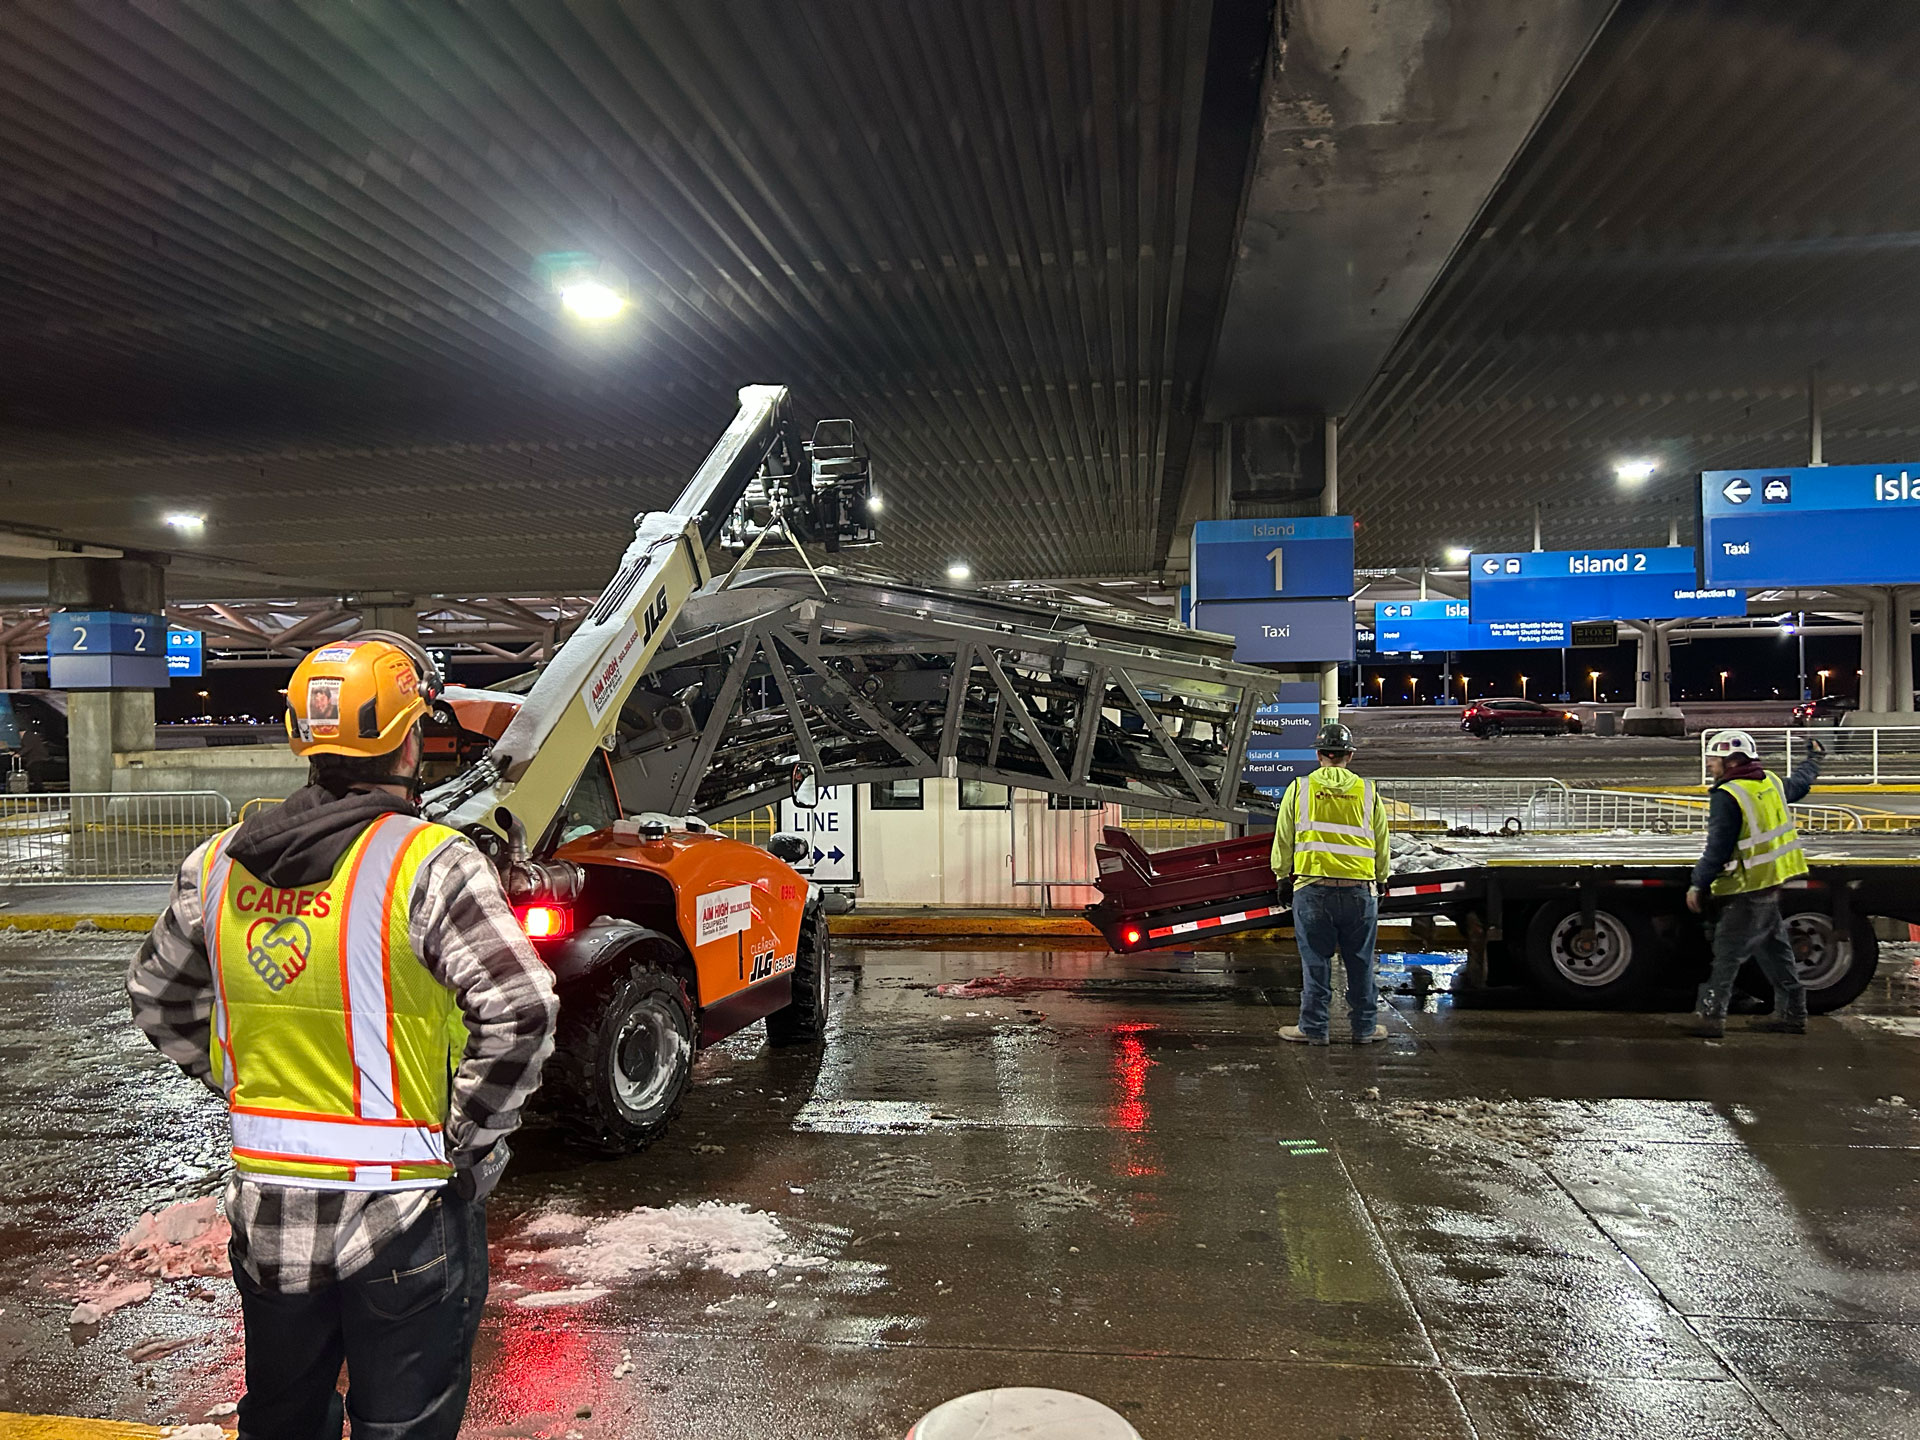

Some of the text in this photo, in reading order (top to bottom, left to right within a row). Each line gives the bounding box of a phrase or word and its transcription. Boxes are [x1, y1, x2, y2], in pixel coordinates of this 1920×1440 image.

[1253, 523, 1295, 537] Island
[1722, 541, 1750, 556] Taxi
[1266, 547, 1284, 592] 1
[1569, 553, 1647, 574] Island 2
[1674, 589, 1695, 599] Limo
[69, 614, 91, 622] Island
[643, 583, 669, 648] JLG
[1262, 624, 1290, 638] Taxi
[1541, 621, 1564, 630] Parking
[72, 626, 88, 651] 2
[134, 628, 146, 652] 2
[591, 679, 605, 703] AIM
[602, 657, 619, 684] HIGH
[594, 667, 621, 710] EQUIPMENT
[1273, 705, 1279, 713] 3
[1281, 717, 1312, 727] Shuttle,
[1249, 751, 1272, 759] Island
[1249, 764, 1294, 772] Rental Cars
[1274, 788, 1280, 796] 5
[794, 812, 839, 832] LINE
[236, 884, 332, 918] CARES
[702, 907, 714, 922] AIM
[715, 901, 729, 919] HIGH
[702, 916, 729, 931] EQUIPMENT
[750, 937, 778, 955] CLEARSKY
[748, 950, 775, 984] JLG
